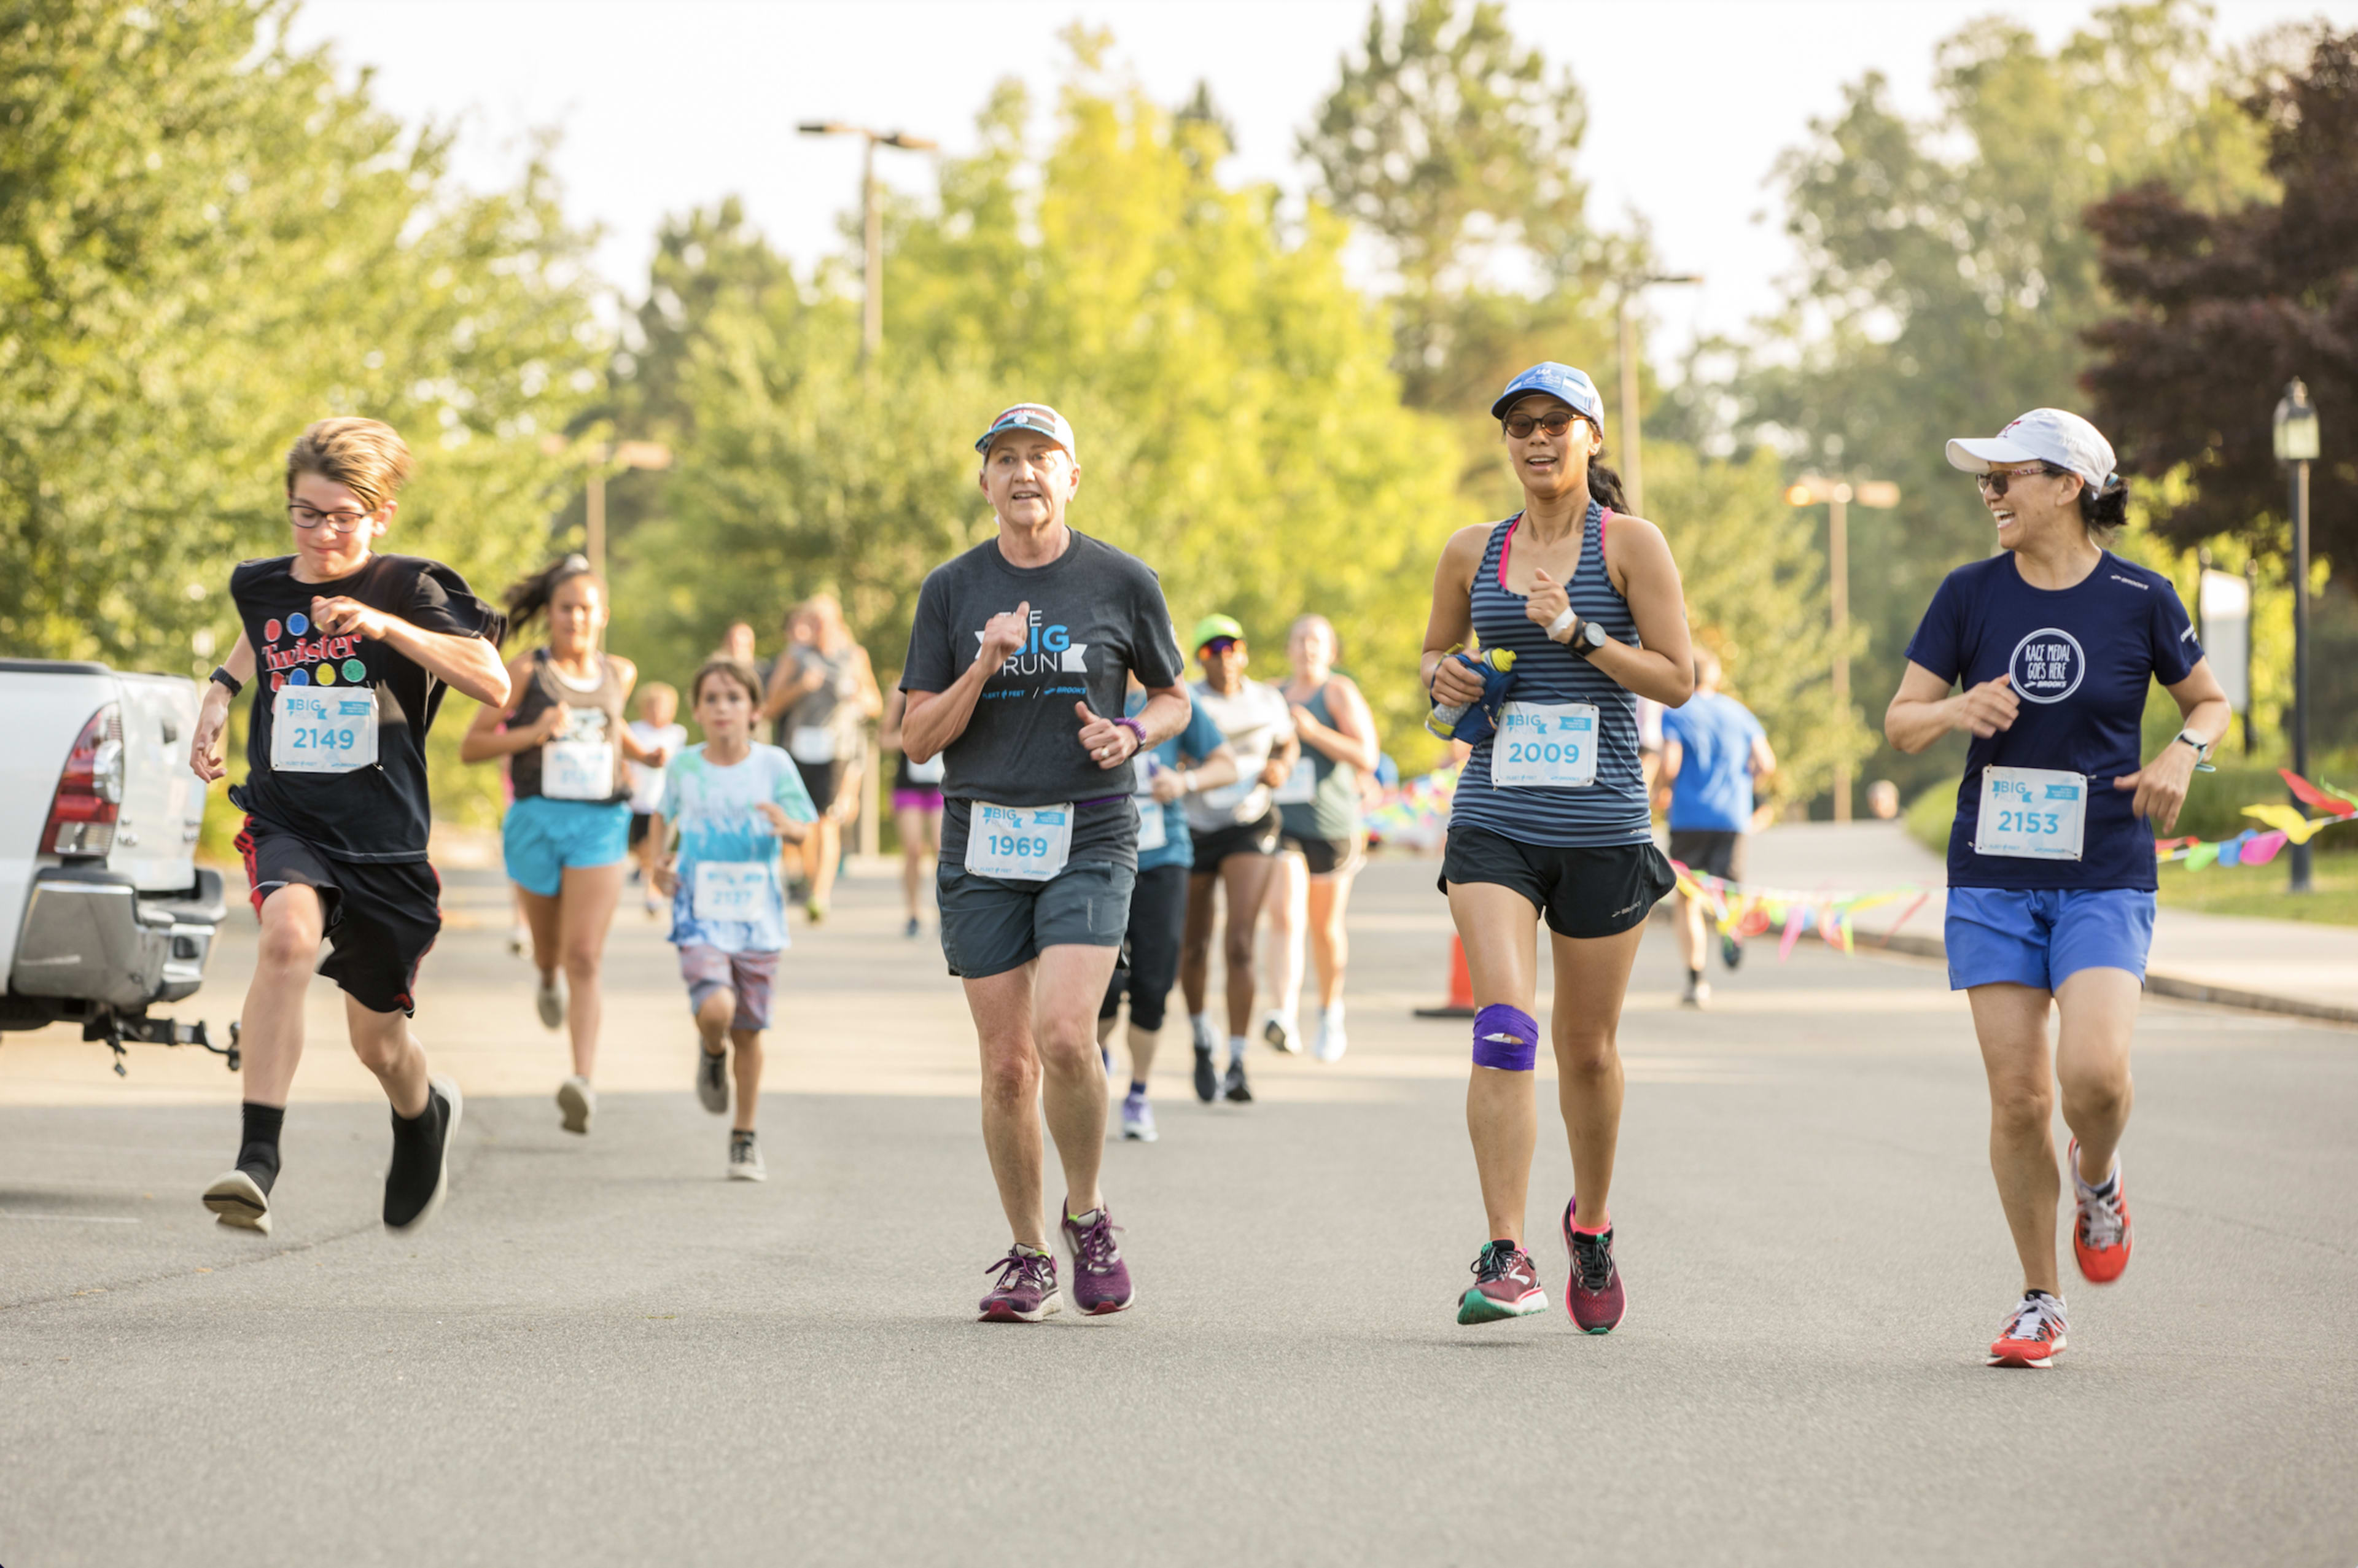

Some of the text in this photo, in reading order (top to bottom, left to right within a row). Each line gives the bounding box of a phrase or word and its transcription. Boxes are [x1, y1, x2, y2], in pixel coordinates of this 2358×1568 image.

[1013, 624, 1070, 656] IG
[262, 633, 362, 672] Twister
[2025, 644, 2071, 662] RACE MEDAL
[1003, 651, 1057, 677] RUN
[2028, 662, 2067, 680] GOES HERE
[1056, 686, 1086, 695] BROOKS
[296, 699, 321, 711] BIG
[1516, 715, 1541, 726] BIG
[293, 728, 354, 750] 2149
[1509, 742, 1579, 764] 2009
[2001, 781, 2026, 794] BIG
[992, 808, 1017, 820] BIG
[1998, 810, 2059, 834] 2153
[988, 835, 1048, 858] 1969
